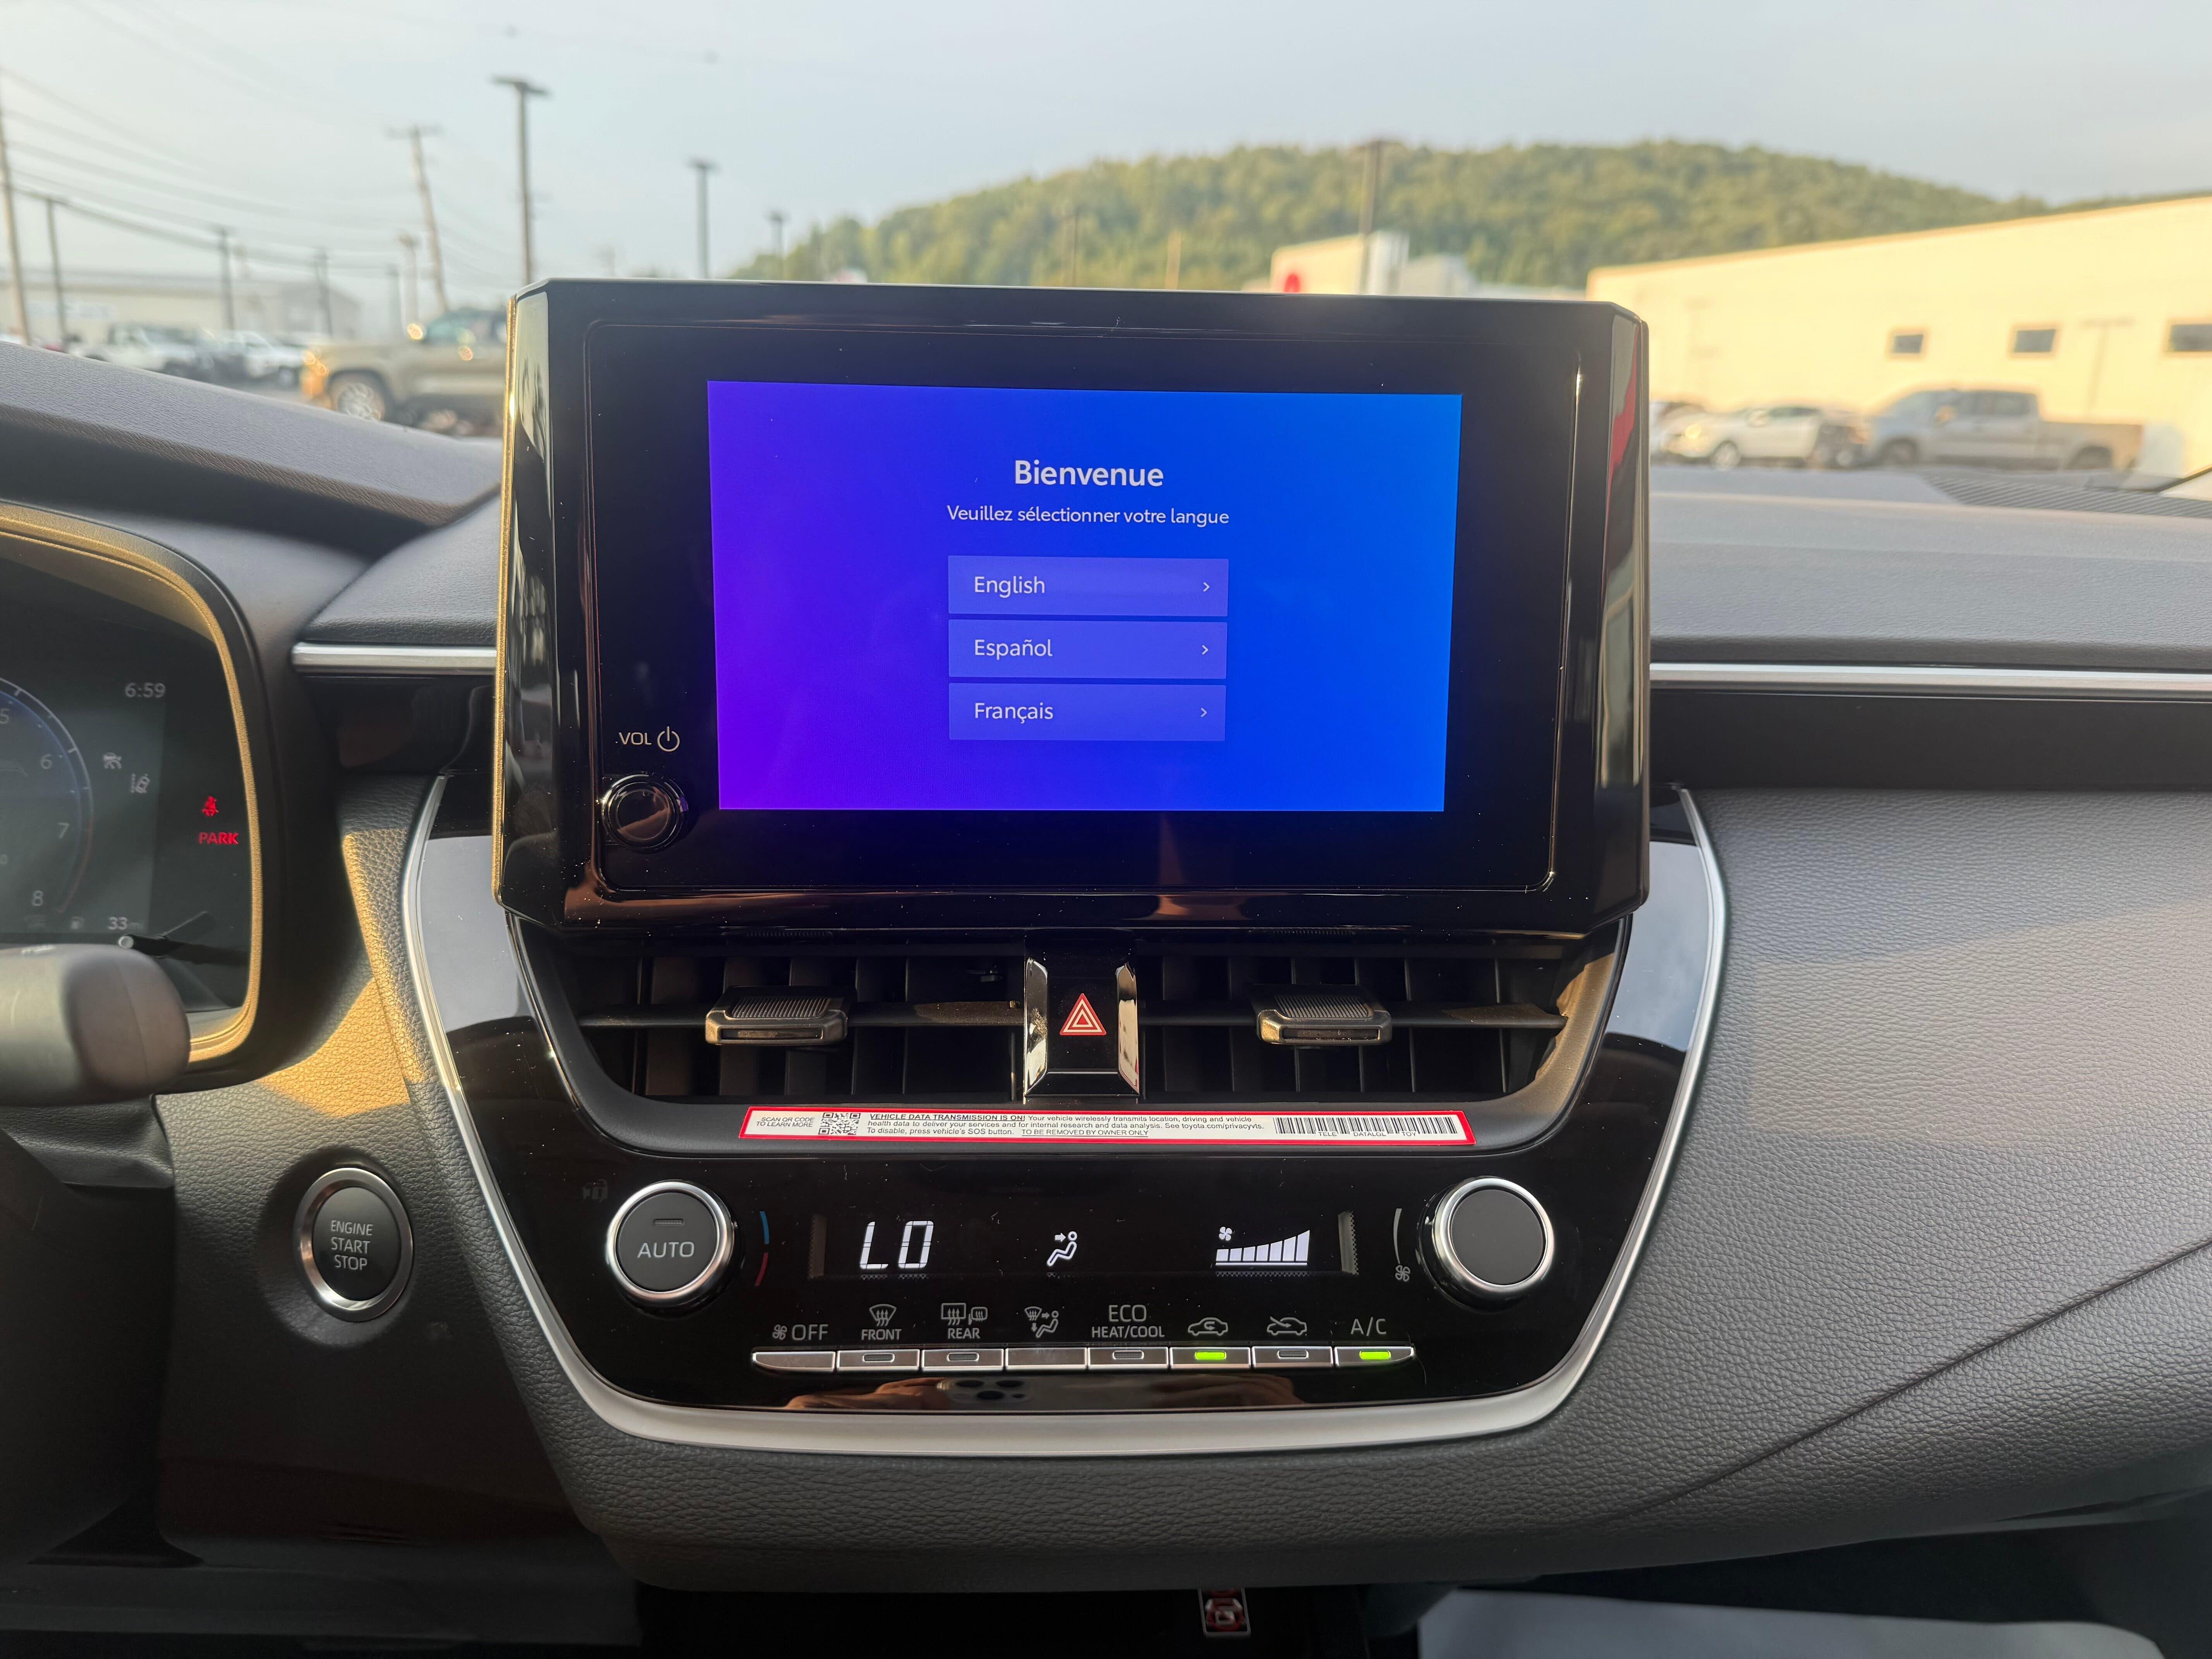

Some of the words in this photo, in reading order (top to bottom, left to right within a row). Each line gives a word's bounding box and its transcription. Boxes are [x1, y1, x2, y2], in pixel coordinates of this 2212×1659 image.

[1015, 459, 1164, 487] Bienvenue
[947, 505, 1012, 521] Veuillez
[1017, 506, 1120, 524] sélectionner
[1123, 510, 1166, 524] votre
[1171, 508, 1229, 527] langue
[974, 576, 1046, 598] English
[974, 639, 1053, 660] Español
[125, 682, 166, 698] 6:59
[974, 702, 1054, 723] Français
[619, 732, 652, 745] VOL
[40, 754, 53, 769] 6
[58, 822, 70, 839] 7
[198, 831, 239, 845] PARK
[32, 890, 44, 907] 8
[108, 916, 128, 930] 33
[331, 1220, 373, 1236] ENGINE
[331, 1237, 371, 1254] START
[637, 1242, 695, 1258] AUTO
[860, 1220, 934, 1269] LO
[334, 1254, 368, 1270] STOP
[1108, 1304, 1147, 1323] ECO
[792, 1324, 828, 1341] OFF
[948, 1328, 980, 1339] REAR
[1091, 1325, 1165, 1339] HEAT/COOL
[1350, 1317, 1387, 1335] A/C
[861, 1329, 902, 1341] FRONT
